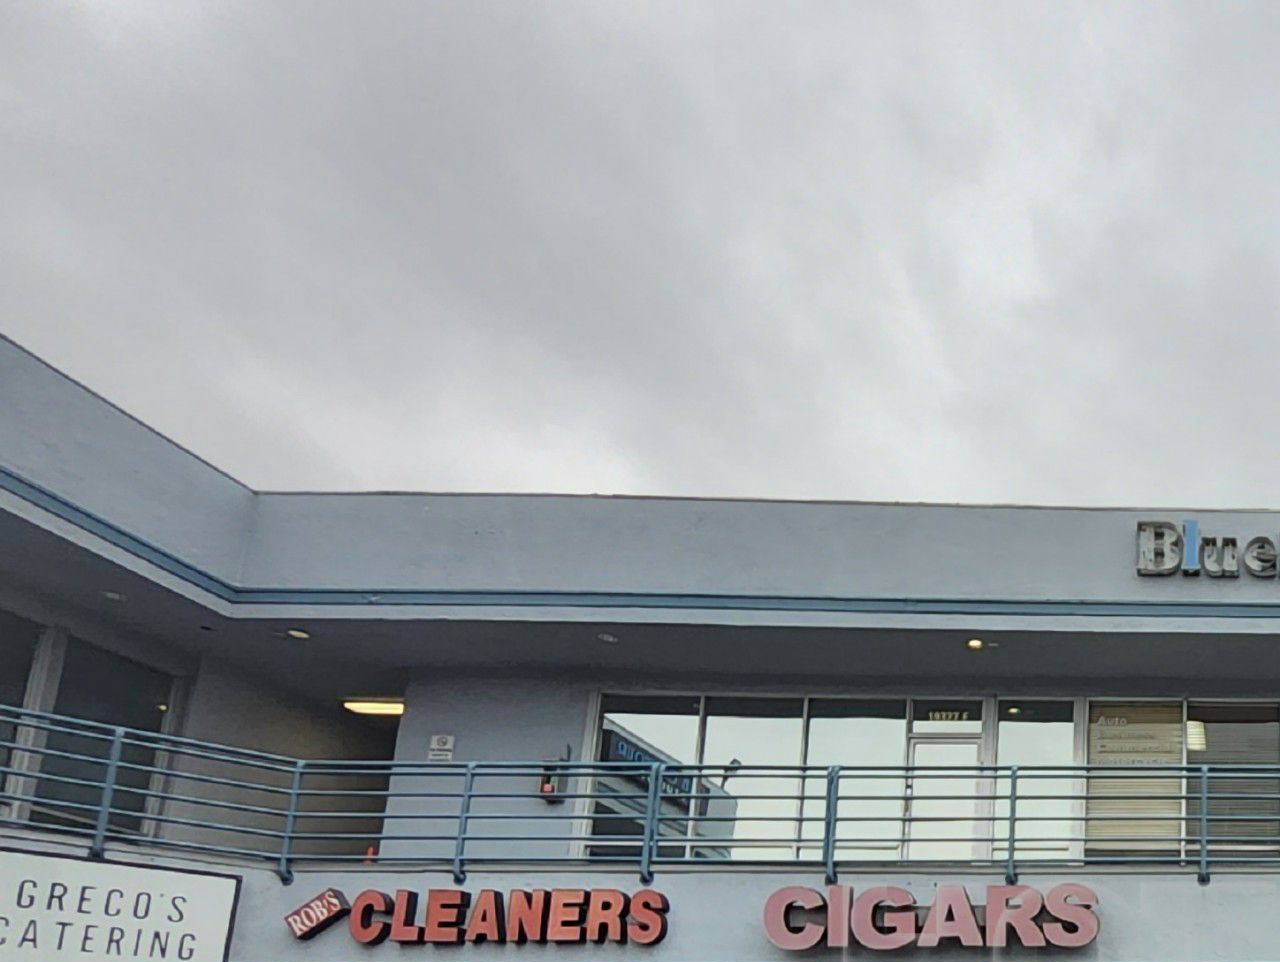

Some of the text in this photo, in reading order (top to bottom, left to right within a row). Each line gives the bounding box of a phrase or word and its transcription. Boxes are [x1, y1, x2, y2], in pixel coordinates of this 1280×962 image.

[16, 879, 188, 923] GRECO'S
[287, 890, 342, 938] ROB'S
[349, 889, 669, 946] CLEANERS
[763, 883, 1099, 951] CIGARS
